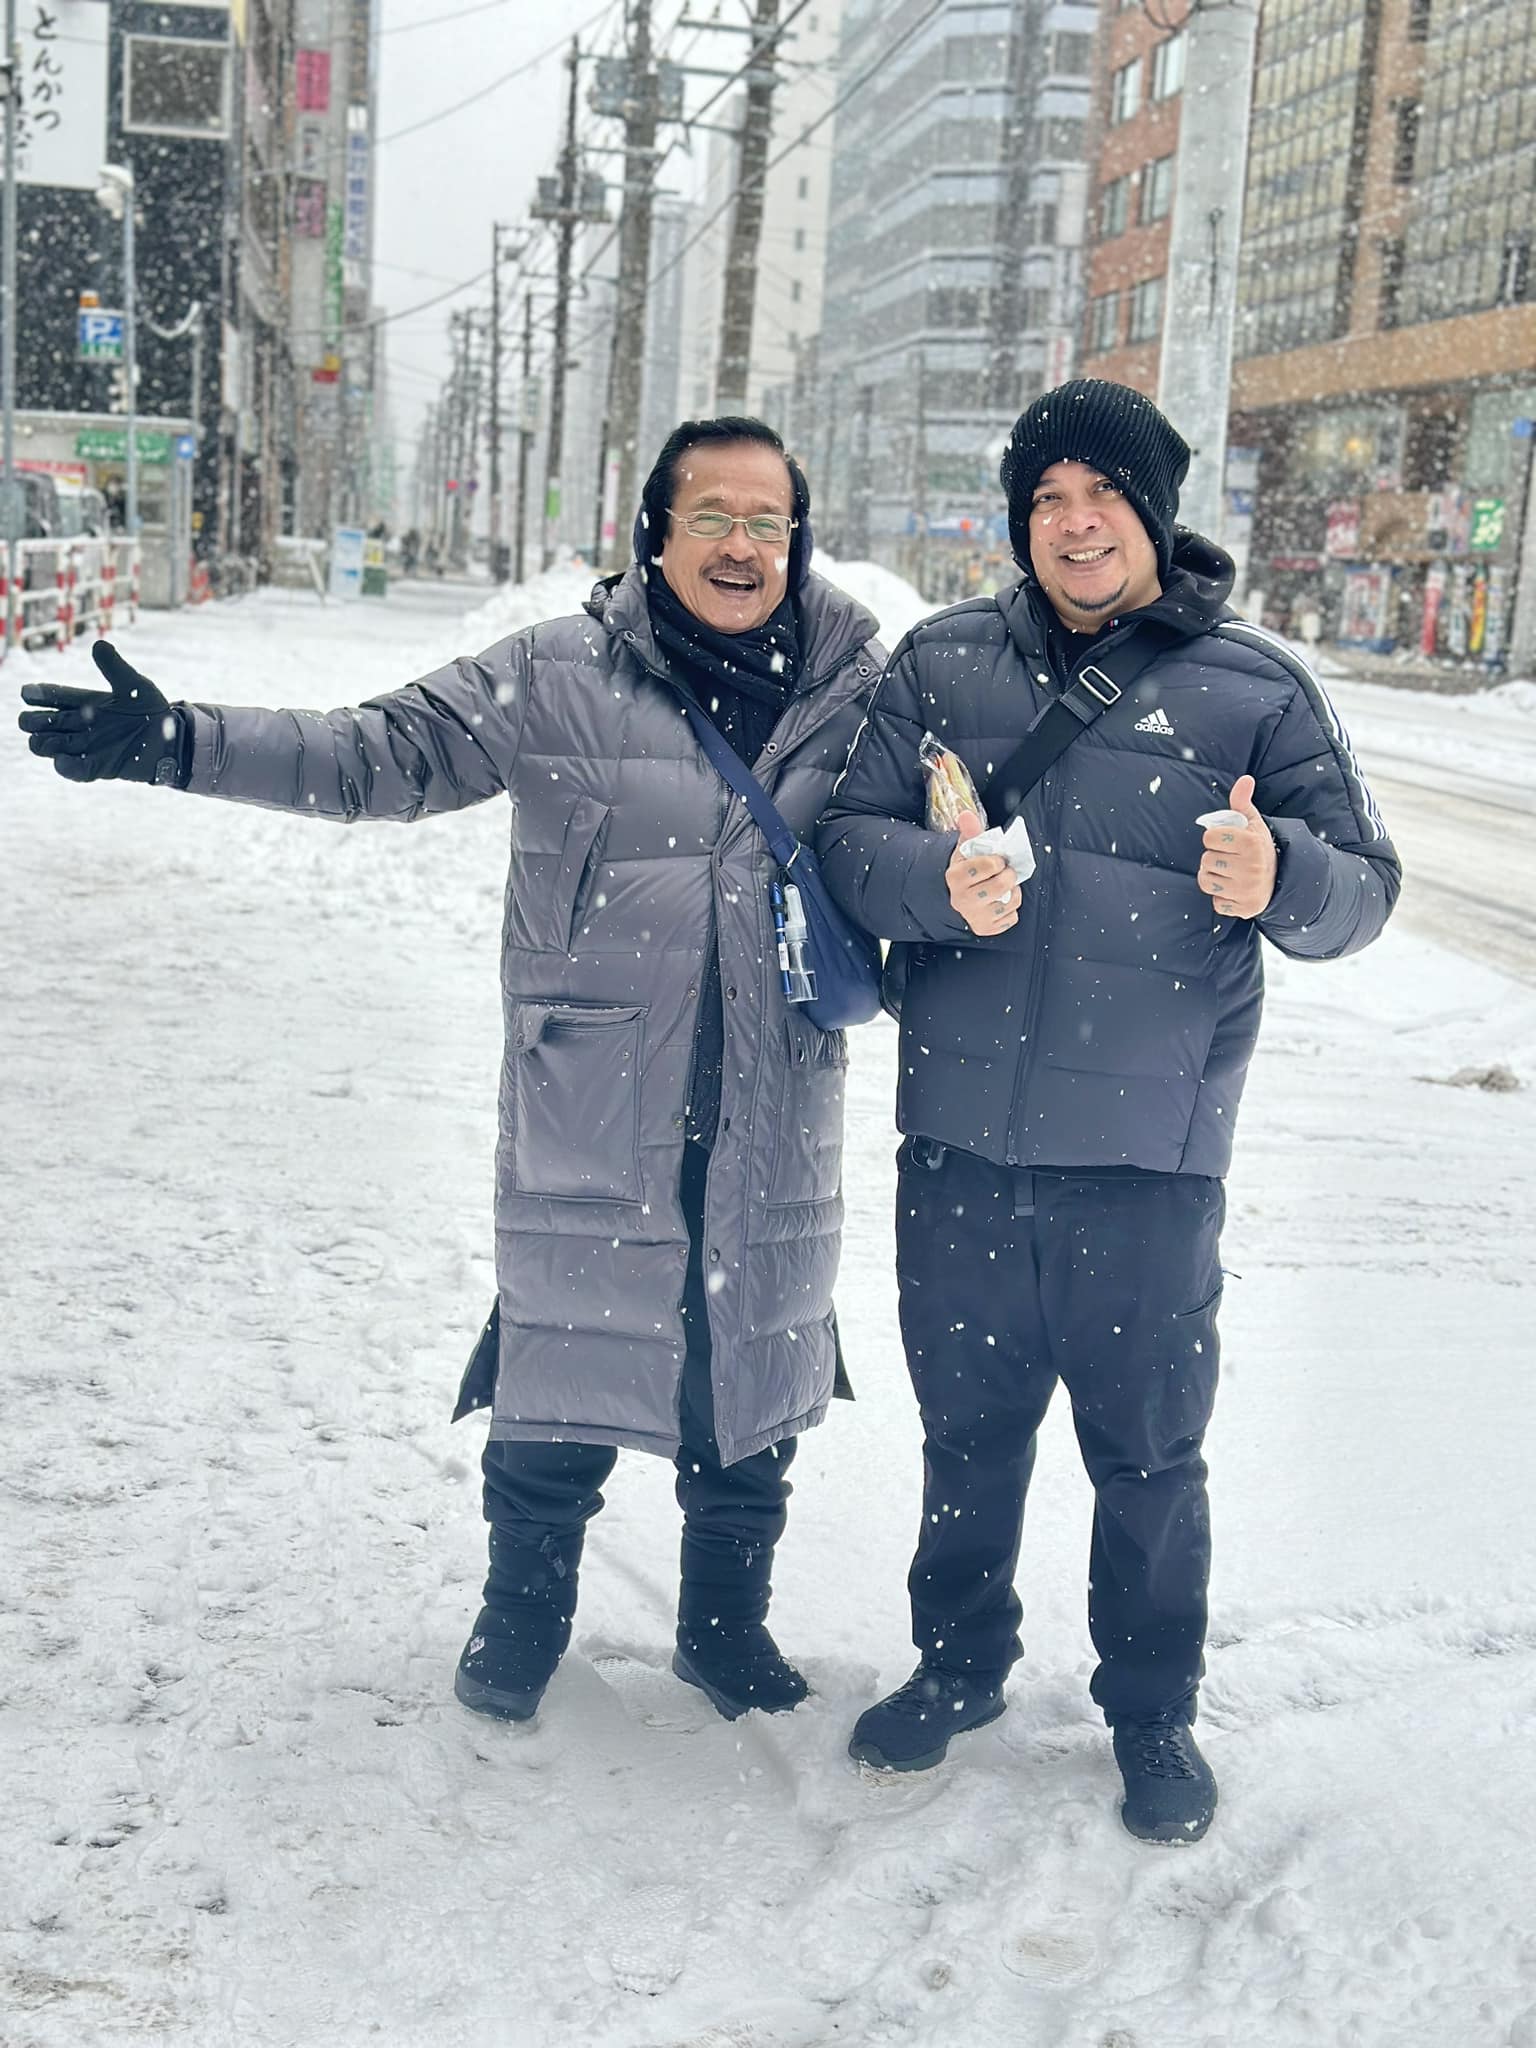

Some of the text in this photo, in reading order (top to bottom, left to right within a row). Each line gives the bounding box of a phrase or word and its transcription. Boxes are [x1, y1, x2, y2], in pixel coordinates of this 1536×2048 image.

[33, 6, 63, 131] とんかつ
[86, 316, 114, 341] P
[1134, 722, 1175, 736] adidas
